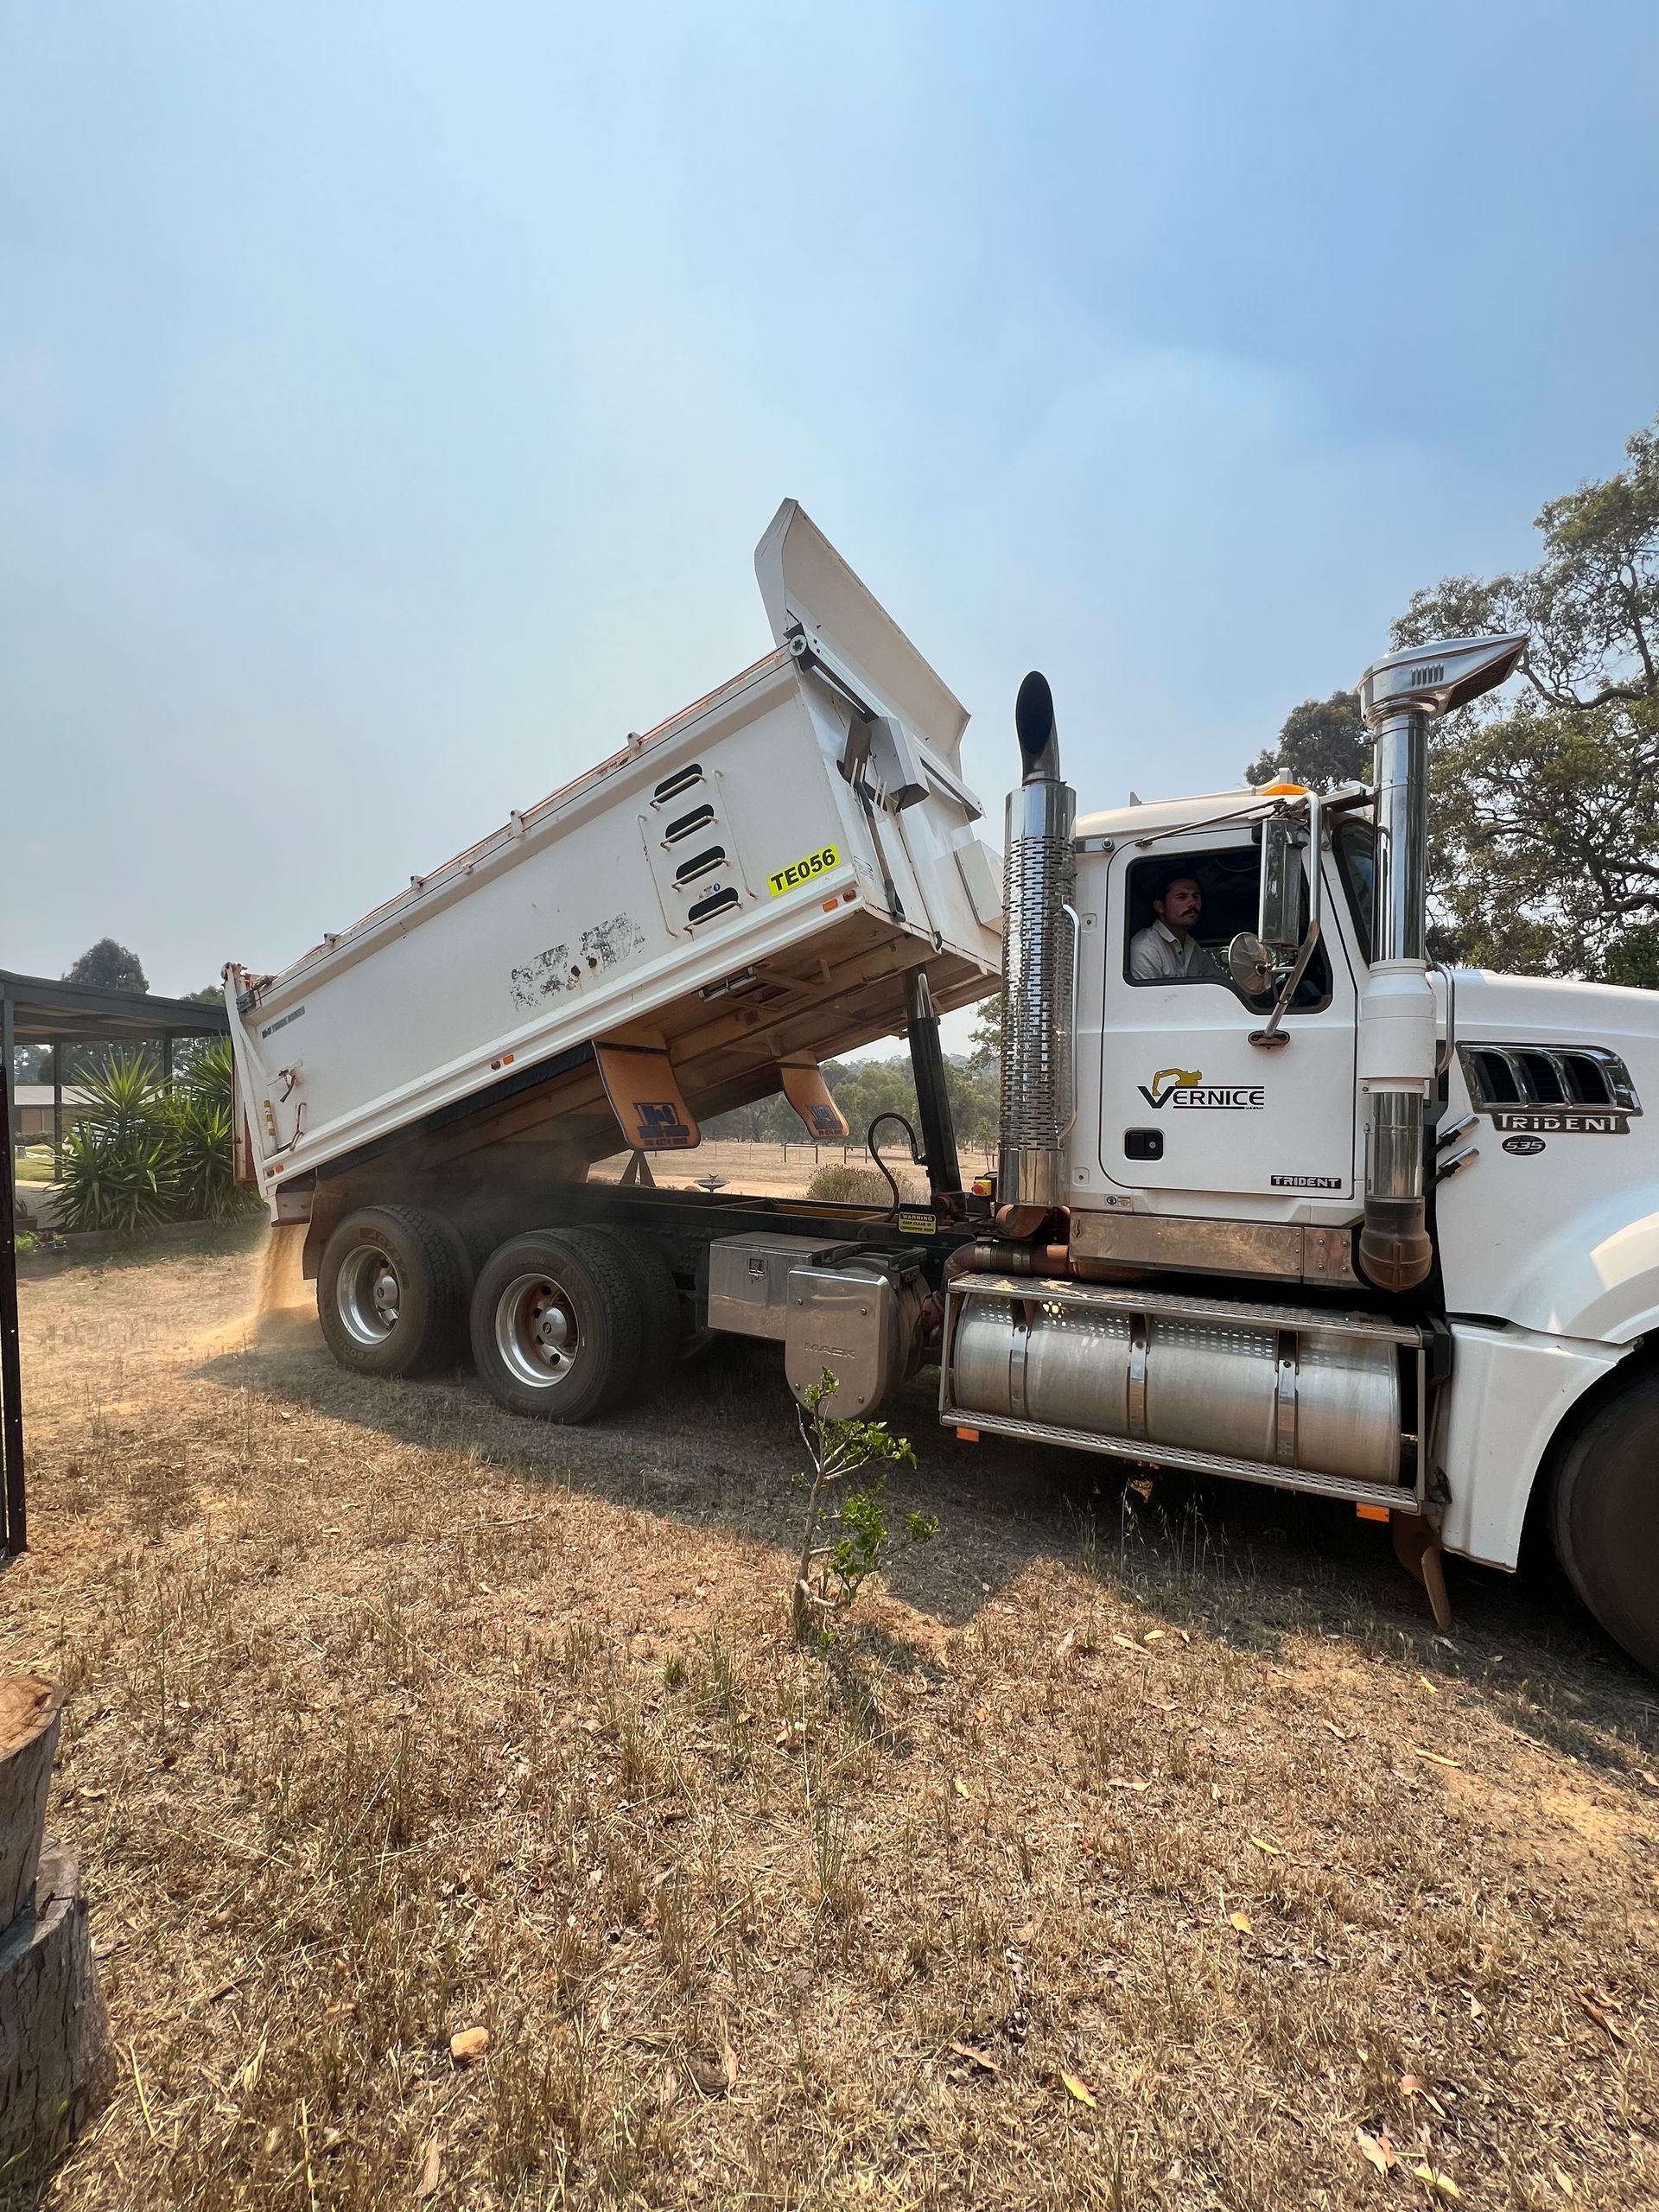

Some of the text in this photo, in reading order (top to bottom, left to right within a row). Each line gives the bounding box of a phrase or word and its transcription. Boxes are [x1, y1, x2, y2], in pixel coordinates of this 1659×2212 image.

[771, 849, 836, 891] TE056
[1137, 1085, 1264, 1109] VERNICE
[1497, 1113, 1620, 1131] TRIDENT
[1505, 1141, 1544, 1150] 535
[1273, 1176, 1340, 1188] TRIDENT
[804, 1343, 856, 1359] MACK
